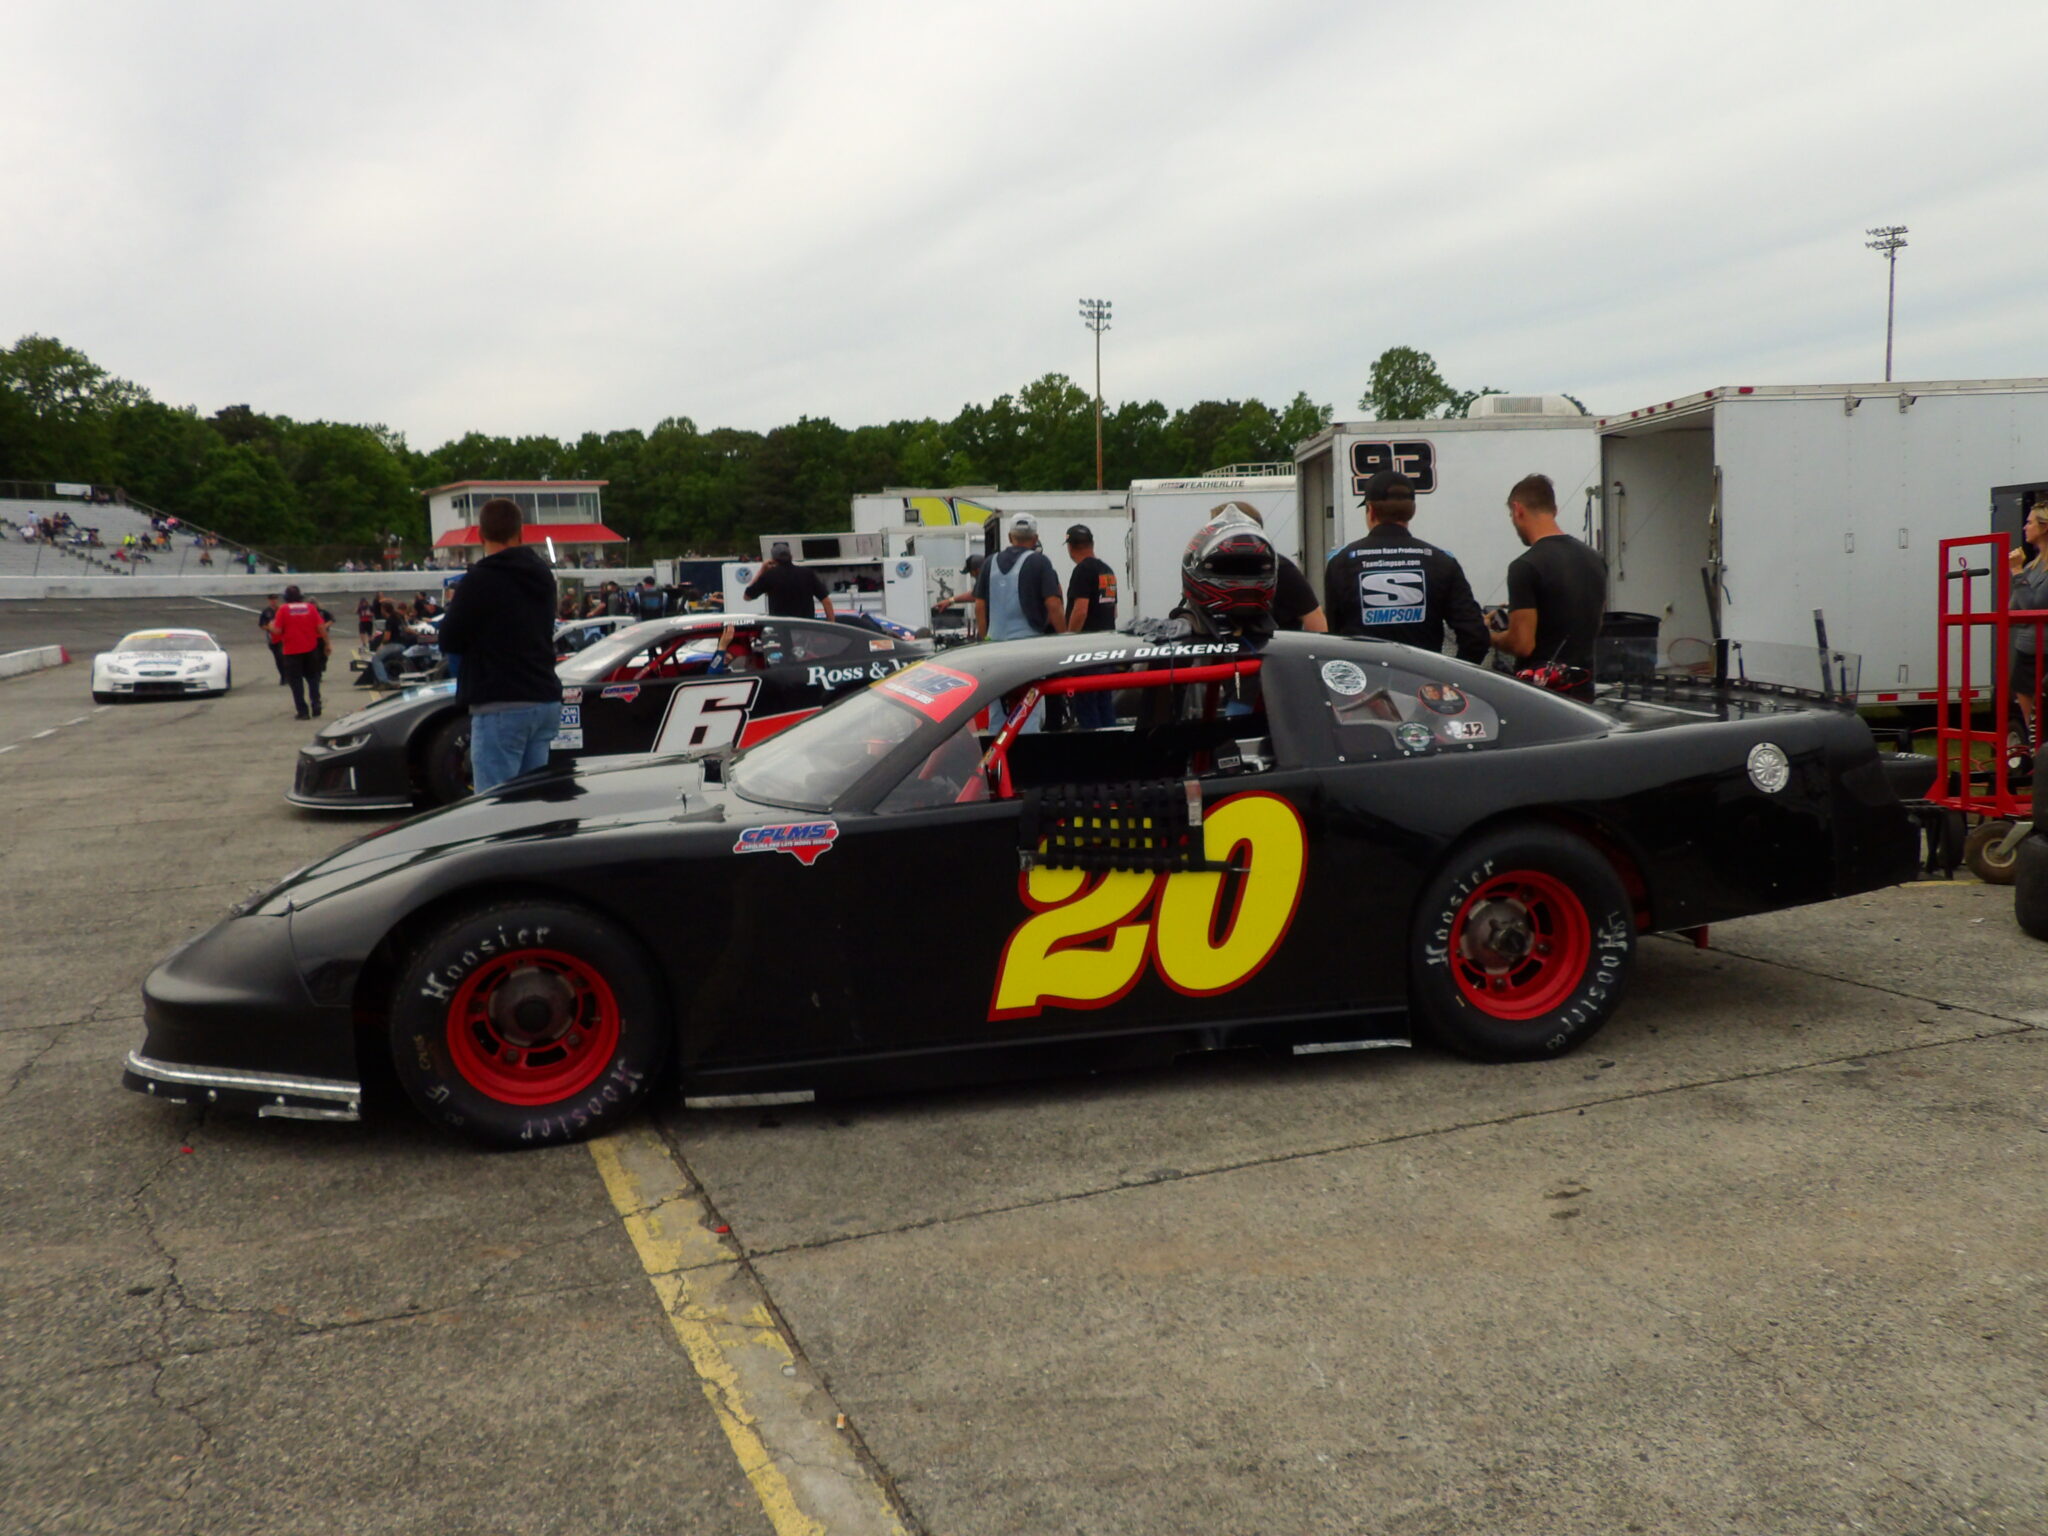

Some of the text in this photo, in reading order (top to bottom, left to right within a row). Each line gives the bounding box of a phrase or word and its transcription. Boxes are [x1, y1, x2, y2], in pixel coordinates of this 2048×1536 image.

[1350, 439, 1437, 496] 93
[1184, 479, 1245, 490] FEATHERLITE
[1364, 608, 1423, 623] SIMPSON
[1059, 643, 1241, 665] JOSH DICKENS
[806, 665, 864, 691] Ross
[869, 661, 890, 680] &
[652, 676, 762, 752] 6
[741, 824, 831, 842] CPLMS
[987, 790, 1309, 1022] 20
